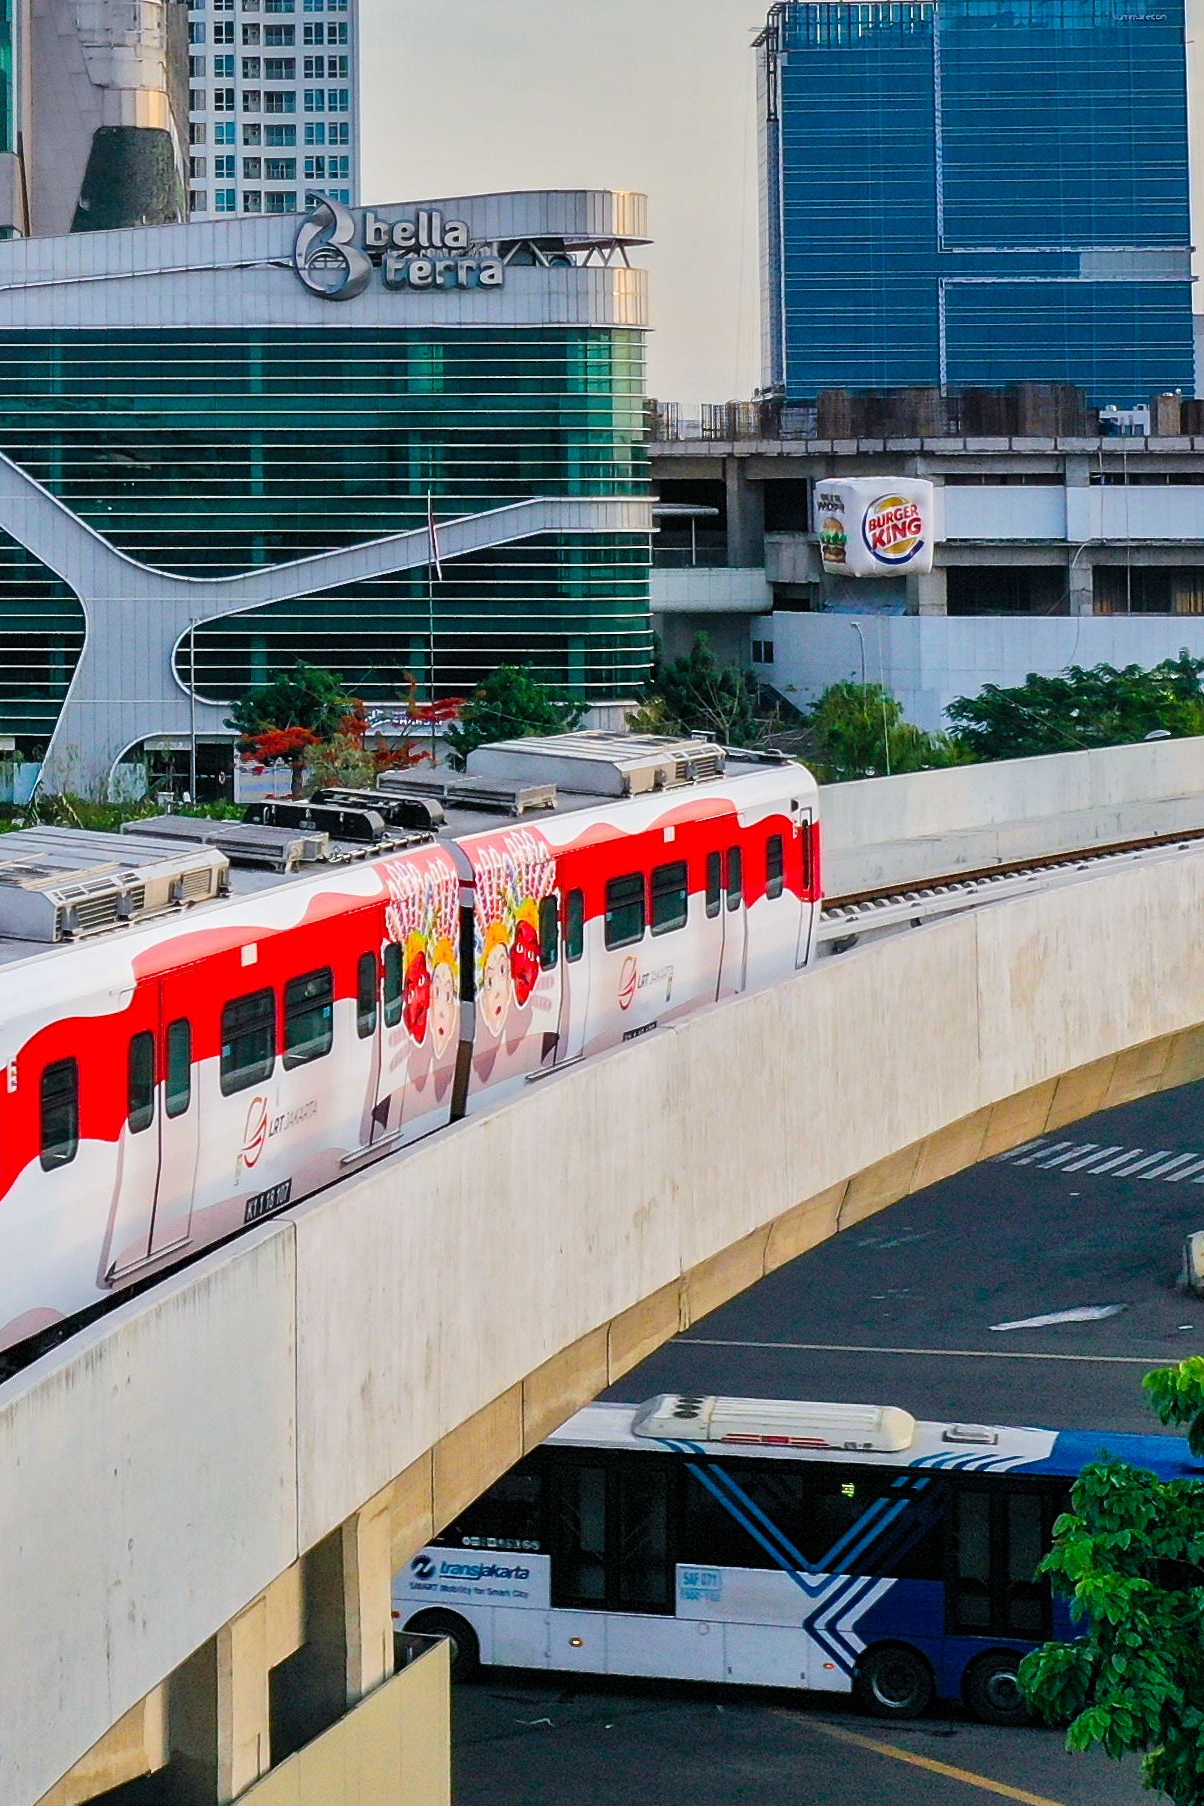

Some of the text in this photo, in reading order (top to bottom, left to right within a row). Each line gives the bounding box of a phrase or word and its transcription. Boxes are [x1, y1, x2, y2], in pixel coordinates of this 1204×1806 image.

[365, 211, 468, 248] bella
[385, 257, 504, 286] terra
[869, 504, 919, 532] BURGER
[870, 517, 922, 550] KING
[269, 1114, 285, 1137] LRT
[439, 1561, 530, 1580] transjakarta
